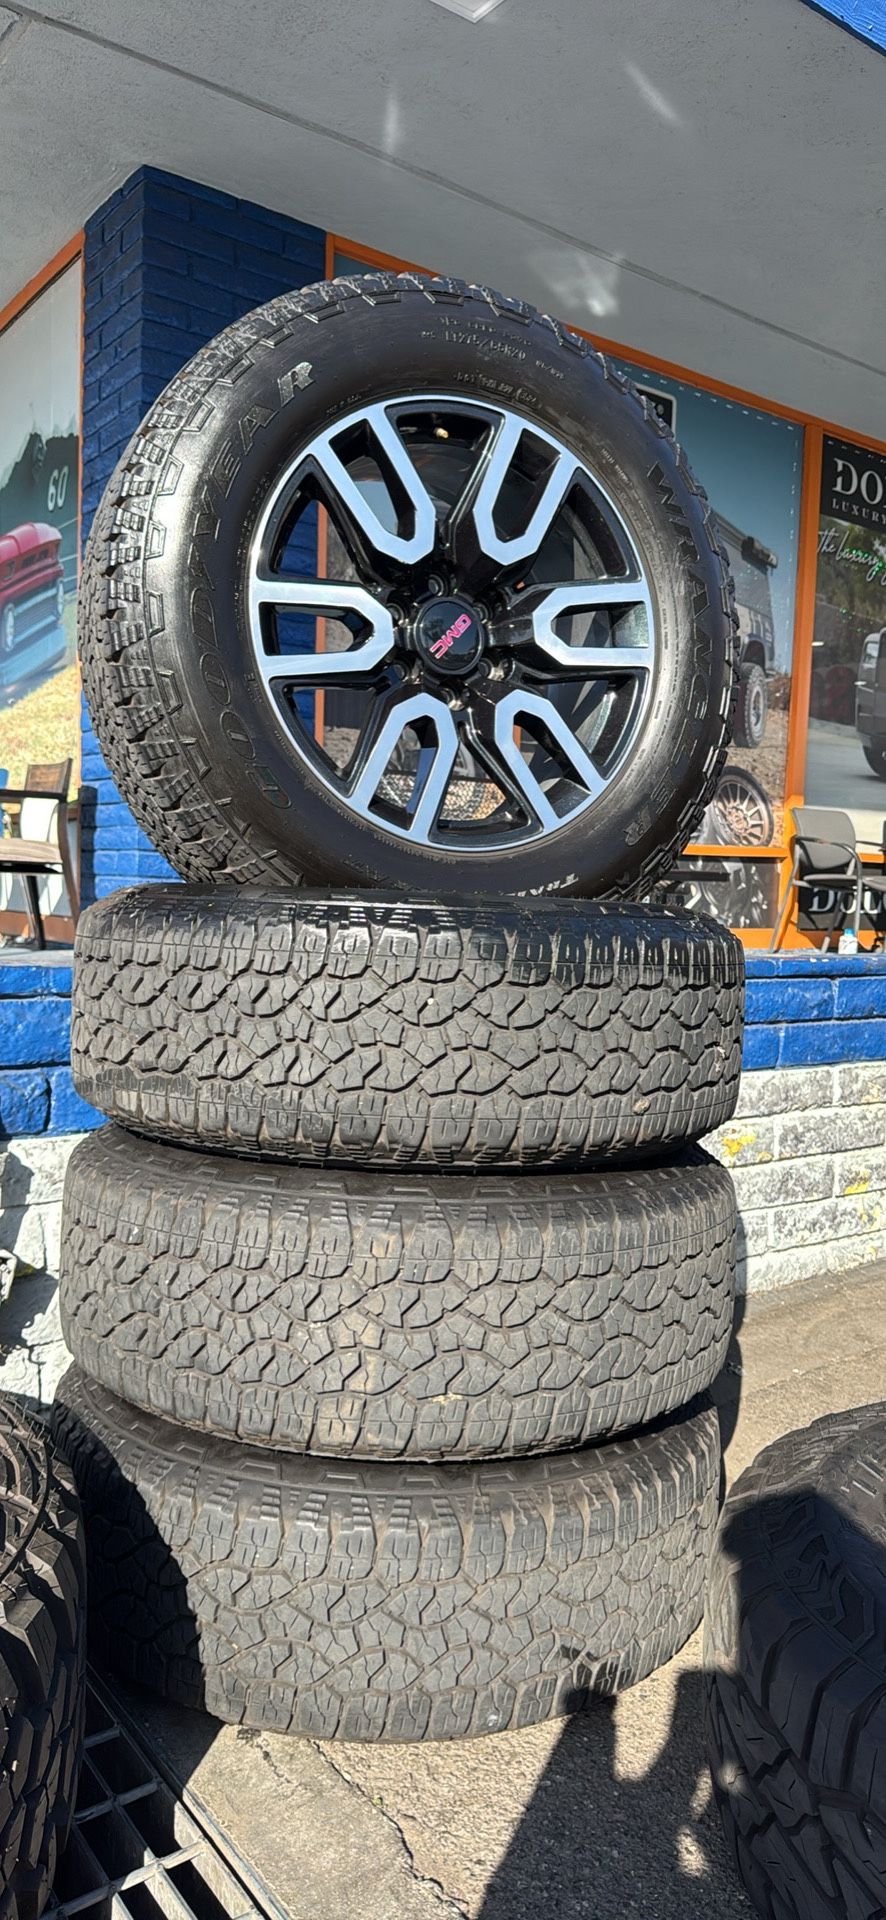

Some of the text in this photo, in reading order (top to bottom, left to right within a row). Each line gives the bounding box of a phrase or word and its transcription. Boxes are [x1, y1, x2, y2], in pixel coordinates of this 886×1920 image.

[48, 466, 69, 511] 60
[832, 457, 886, 505] DO
[190, 361, 315, 808] GOODYEAR
[429, 613, 472, 659] GMC
[623, 461, 713, 846] WRANGLER
